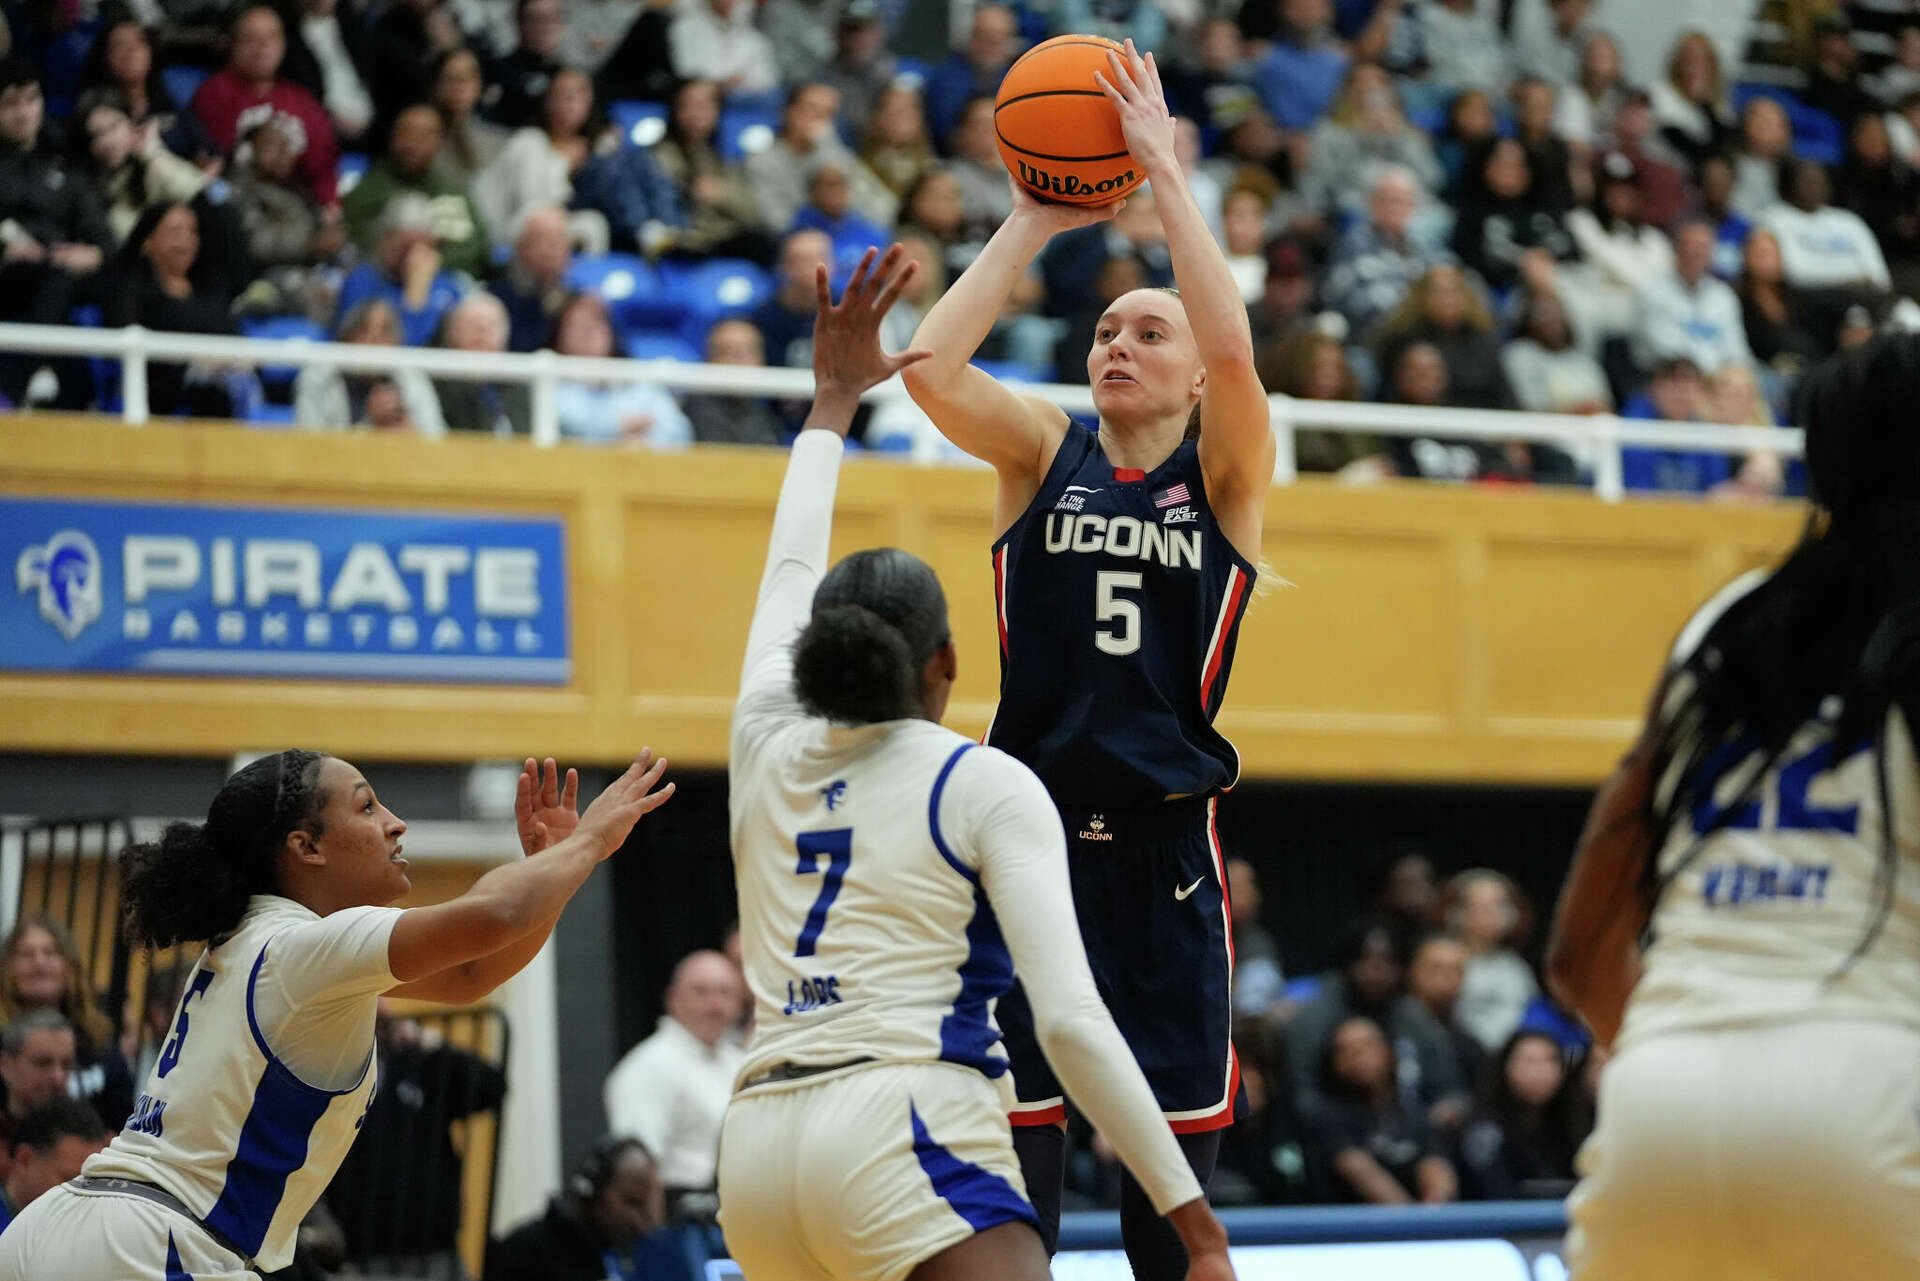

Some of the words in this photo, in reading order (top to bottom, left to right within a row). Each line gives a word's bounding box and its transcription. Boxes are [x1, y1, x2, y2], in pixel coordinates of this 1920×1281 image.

[1018, 159, 1136, 195] Wilson
[1054, 501, 1084, 512] HANGE
[1068, 495, 1086, 506] THE
[1162, 511, 1199, 523] EAST
[1165, 505, 1191, 518] BIG
[1045, 513, 1203, 570] UCONN
[122, 534, 541, 617] PIRATE
[122, 608, 542, 652] BASKETBALL
[1095, 570, 1143, 656] 5
[1078, 830, 1113, 841] UCONN
[794, 826, 854, 958] 7
[157, 968, 215, 1080] 5
